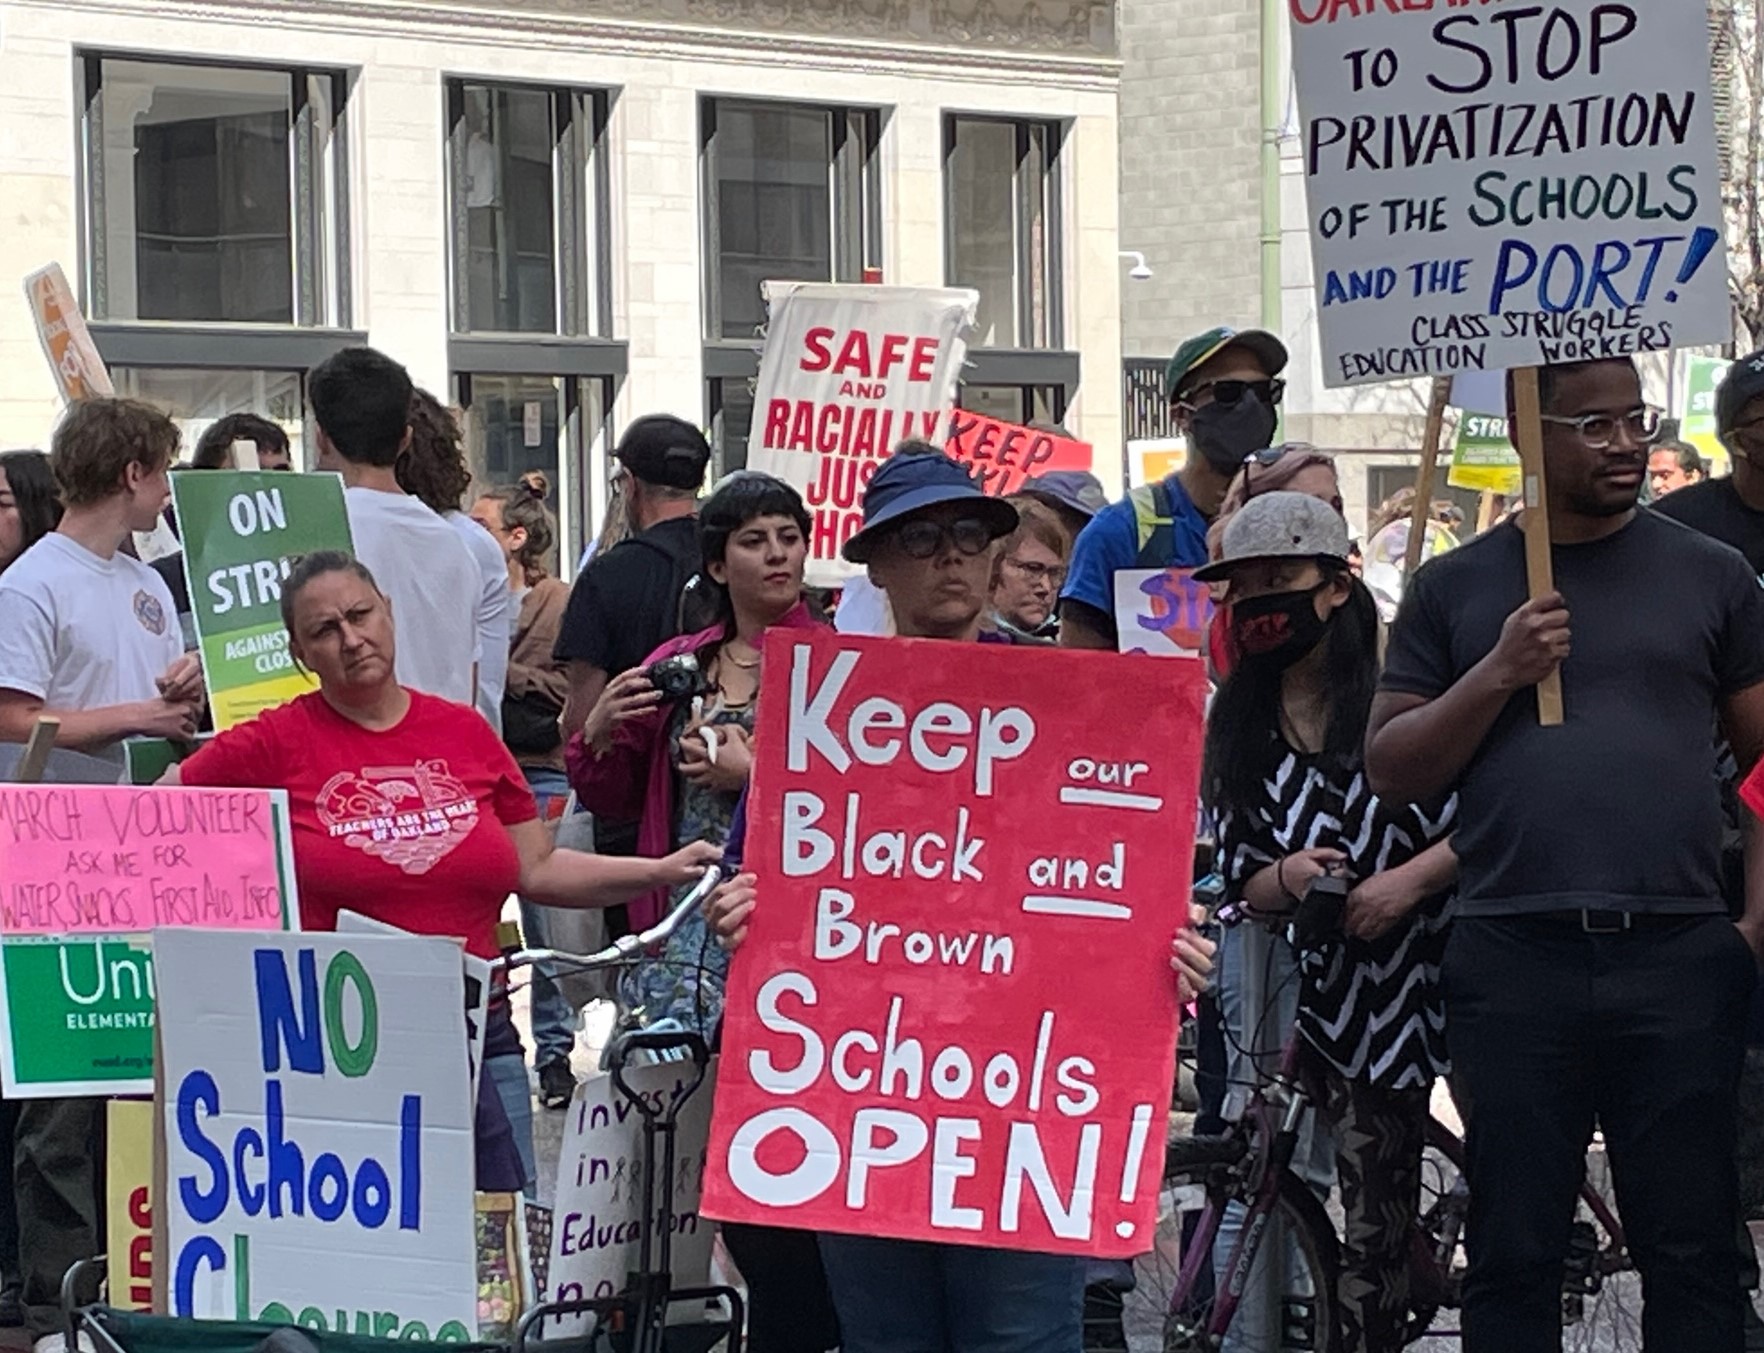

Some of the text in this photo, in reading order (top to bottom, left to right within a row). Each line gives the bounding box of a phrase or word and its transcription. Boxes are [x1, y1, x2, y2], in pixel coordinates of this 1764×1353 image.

[1344, 4, 1637, 93] TO STOP
[1308, 91, 1695, 176] PRIVATIZATION
[1319, 165, 1698, 239] OF THE SCHOOLS
[1322, 226, 1719, 317] AND THE PORT!
[800, 326, 941, 382] SAFE
[1339, 321, 1672, 381] EDUCATION WORKERS
[1412, 305, 1642, 345] CLASS STRUGGLE
[838, 380, 887, 400] AND
[945, 412, 1054, 472] KEEP
[229, 488, 287, 536] ON
[225, 628, 291, 661] AGAINST
[785, 643, 1150, 797] Keep our
[103, 790, 268, 846] VOLUNTEER
[782, 791, 1125, 889] Black and
[64, 843, 192, 877] ASK ME FOR
[149, 876, 199, 926] FIRST
[813, 888, 1015, 975] Brown
[254, 949, 378, 1078] NO
[748, 971, 1101, 1118] Schools
[177, 1070, 421, 1231] School
[576, 1153, 609, 1187] in
[726, 1103, 1154, 1242] OPEN!
[560, 1212, 698, 1256] Educaion
